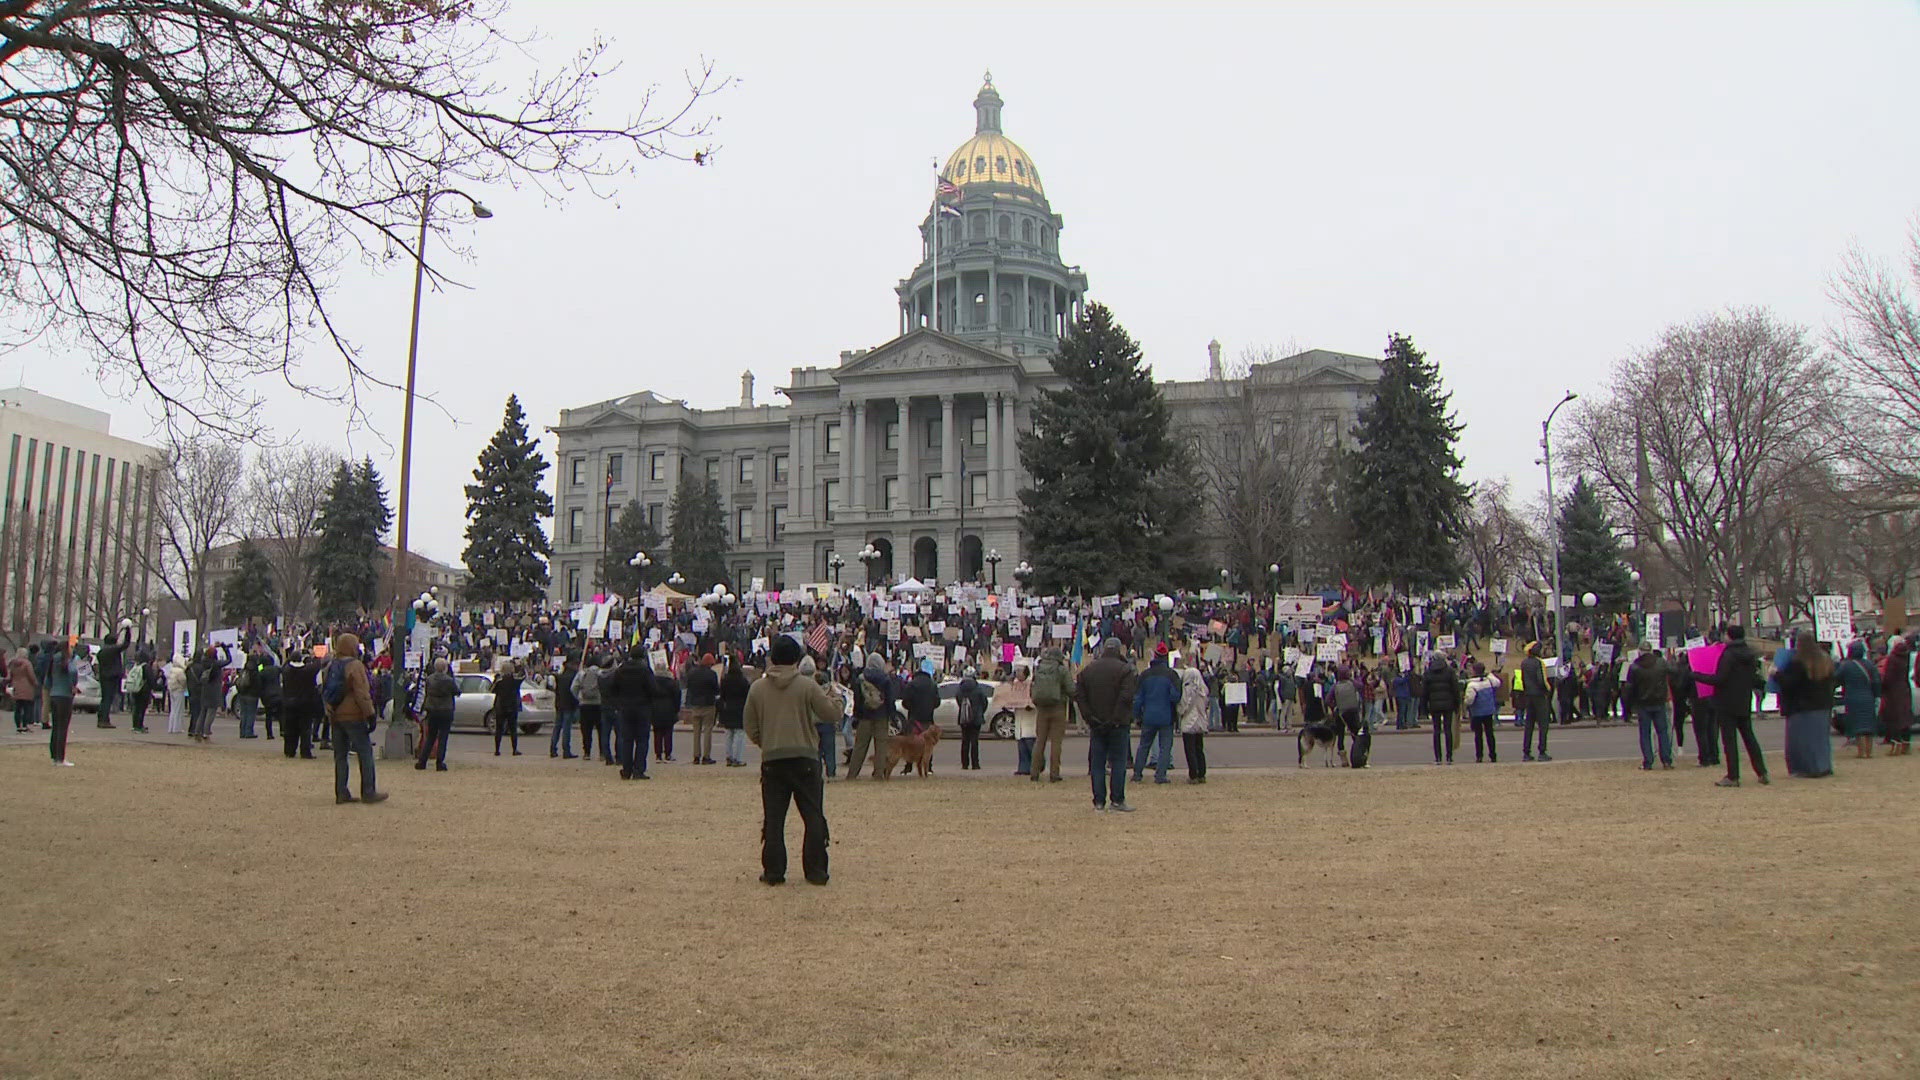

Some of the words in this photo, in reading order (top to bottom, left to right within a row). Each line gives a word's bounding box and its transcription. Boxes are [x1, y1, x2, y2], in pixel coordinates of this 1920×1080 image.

[1815, 599, 1847, 612] KING
[1818, 612, 1849, 624] FREE
[1820, 630, 1847, 639] 1776
